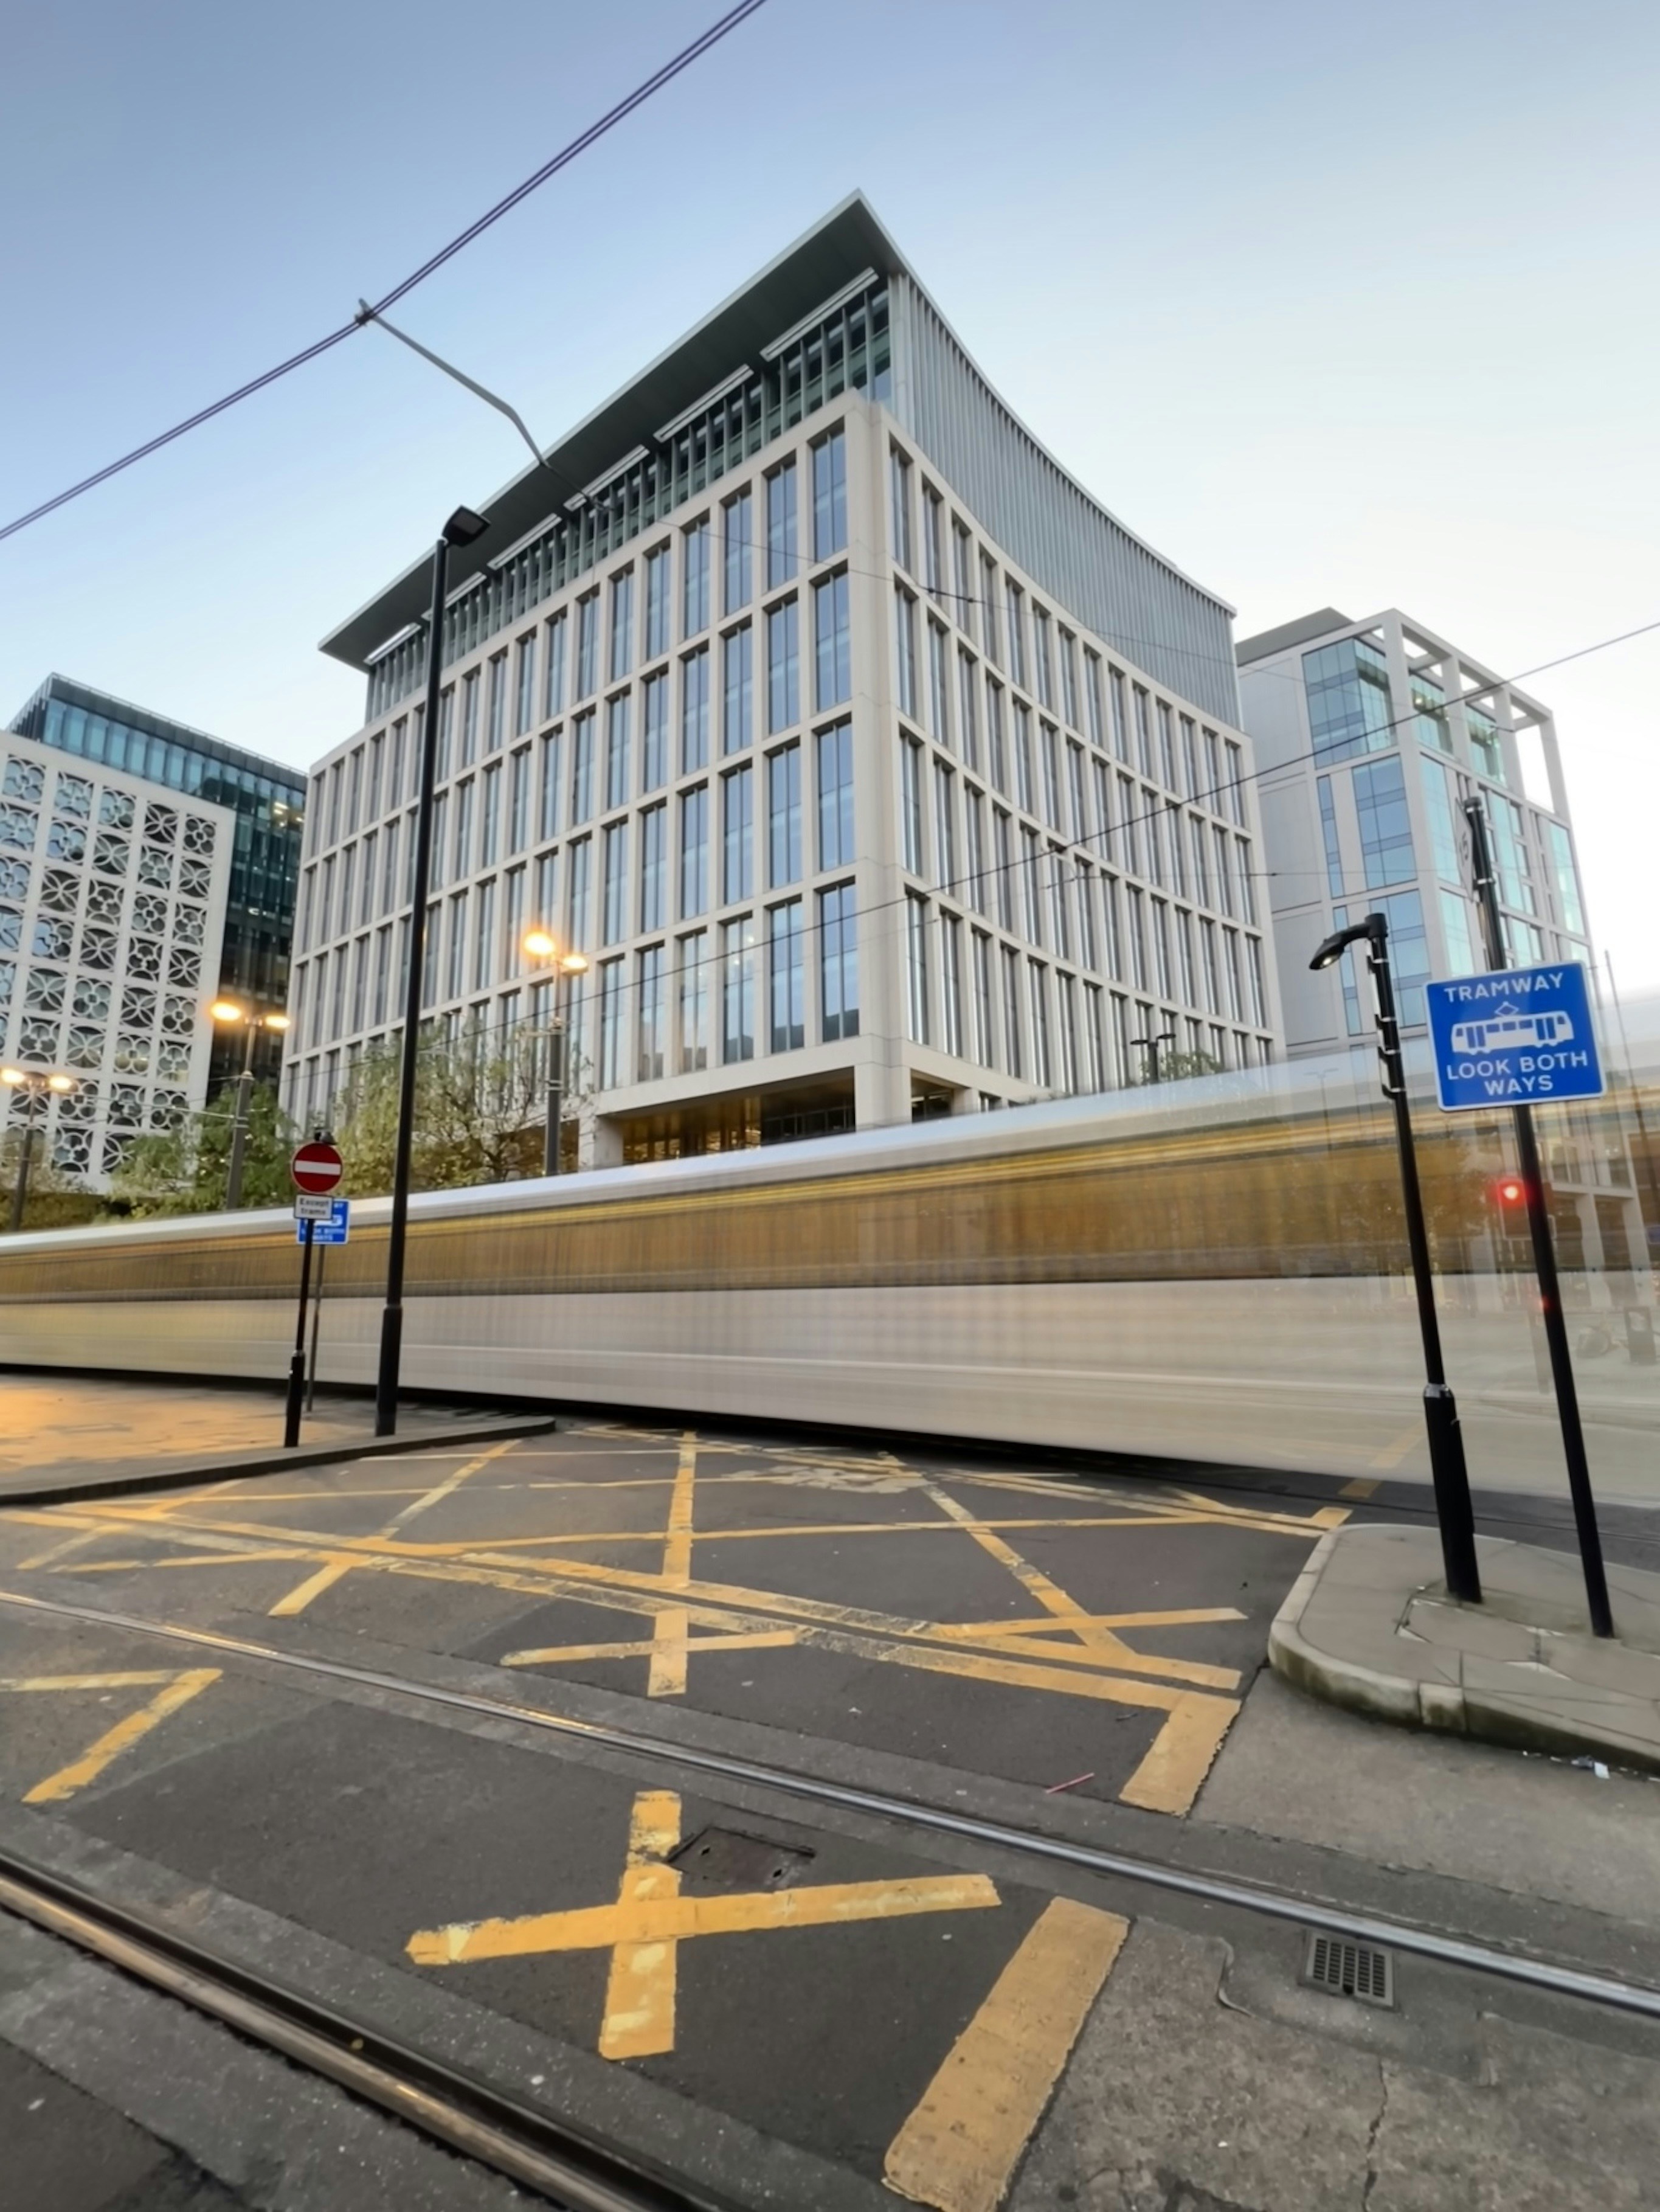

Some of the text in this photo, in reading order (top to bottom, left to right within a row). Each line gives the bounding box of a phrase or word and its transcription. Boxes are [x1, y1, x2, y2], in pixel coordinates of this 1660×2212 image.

[1444, 972, 1564, 1003] TRAMWAY
[1446, 1050, 1588, 1081] LOOK BOTH
[1484, 1074, 1554, 1096] WAYS
[300, 1198, 329, 1207] Except
